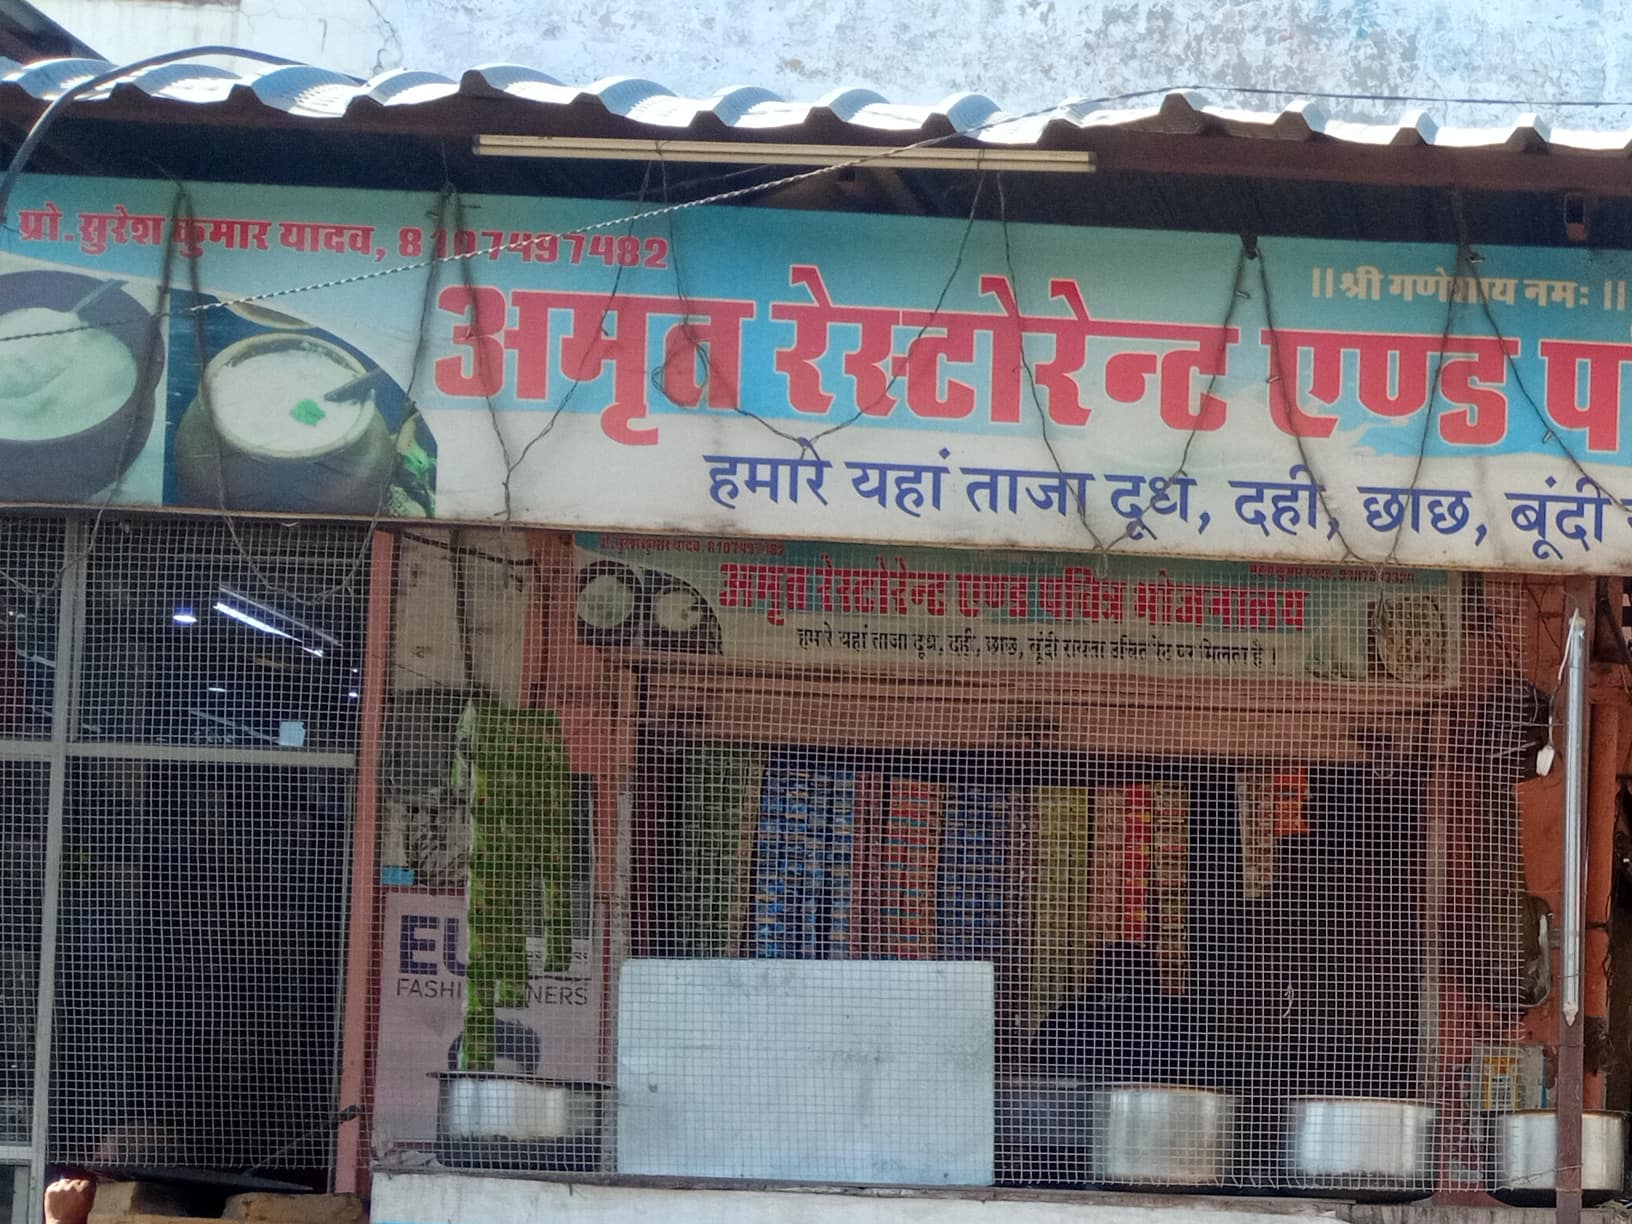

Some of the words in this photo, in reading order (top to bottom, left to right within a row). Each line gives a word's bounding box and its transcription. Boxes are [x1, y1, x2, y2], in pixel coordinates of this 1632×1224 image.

[279, 221, 386, 261] यादव,
[399, 227, 669, 268] 8107497482
[434, 284, 755, 446] अमृत
[770, 264, 1240, 432] रेस्टोरेन्ट
[1260, 327, 1521, 447] एण्ड
[703, 442, 831, 508] हमारे
[845, 448, 951, 515] यहां
[961, 467, 1095, 518] ताजा
[1104, 472, 1211, 541] दूध,
[1358, 486, 1488, 546] छाछ,
[1504, 475, 1618, 560] बूंदी
